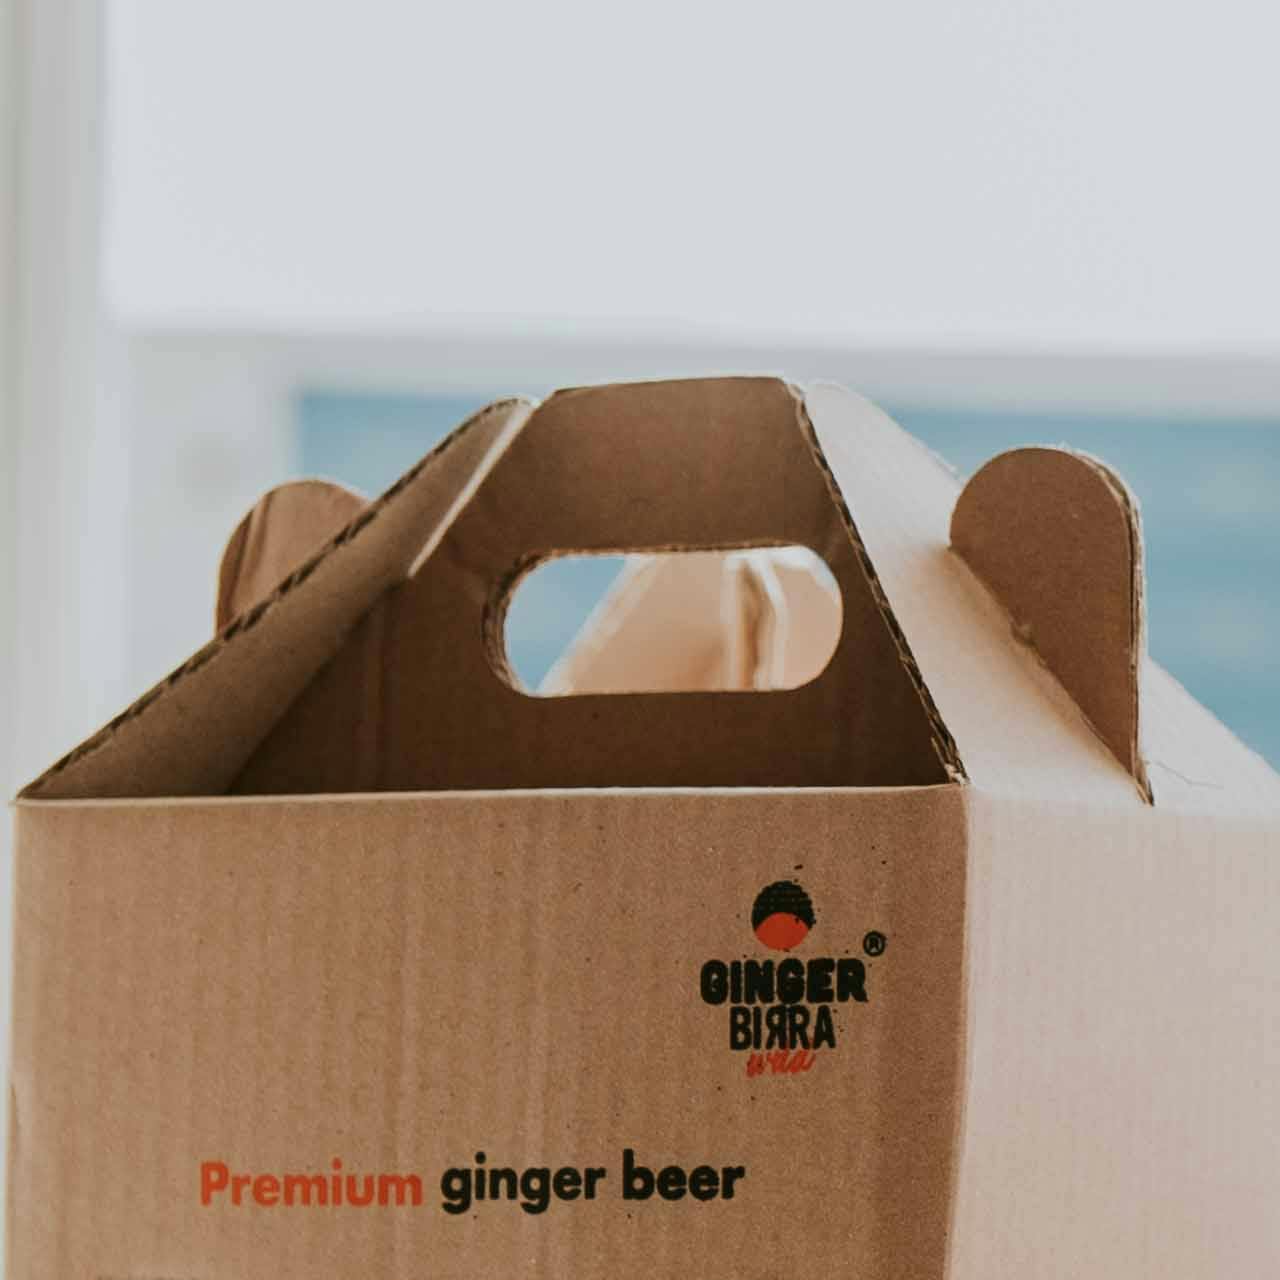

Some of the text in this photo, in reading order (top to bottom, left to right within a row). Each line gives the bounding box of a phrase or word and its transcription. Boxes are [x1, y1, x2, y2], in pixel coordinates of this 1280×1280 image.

[701, 958, 868, 1005] GINGER
[201, 1149, 745, 1215] Premium ginger beer
